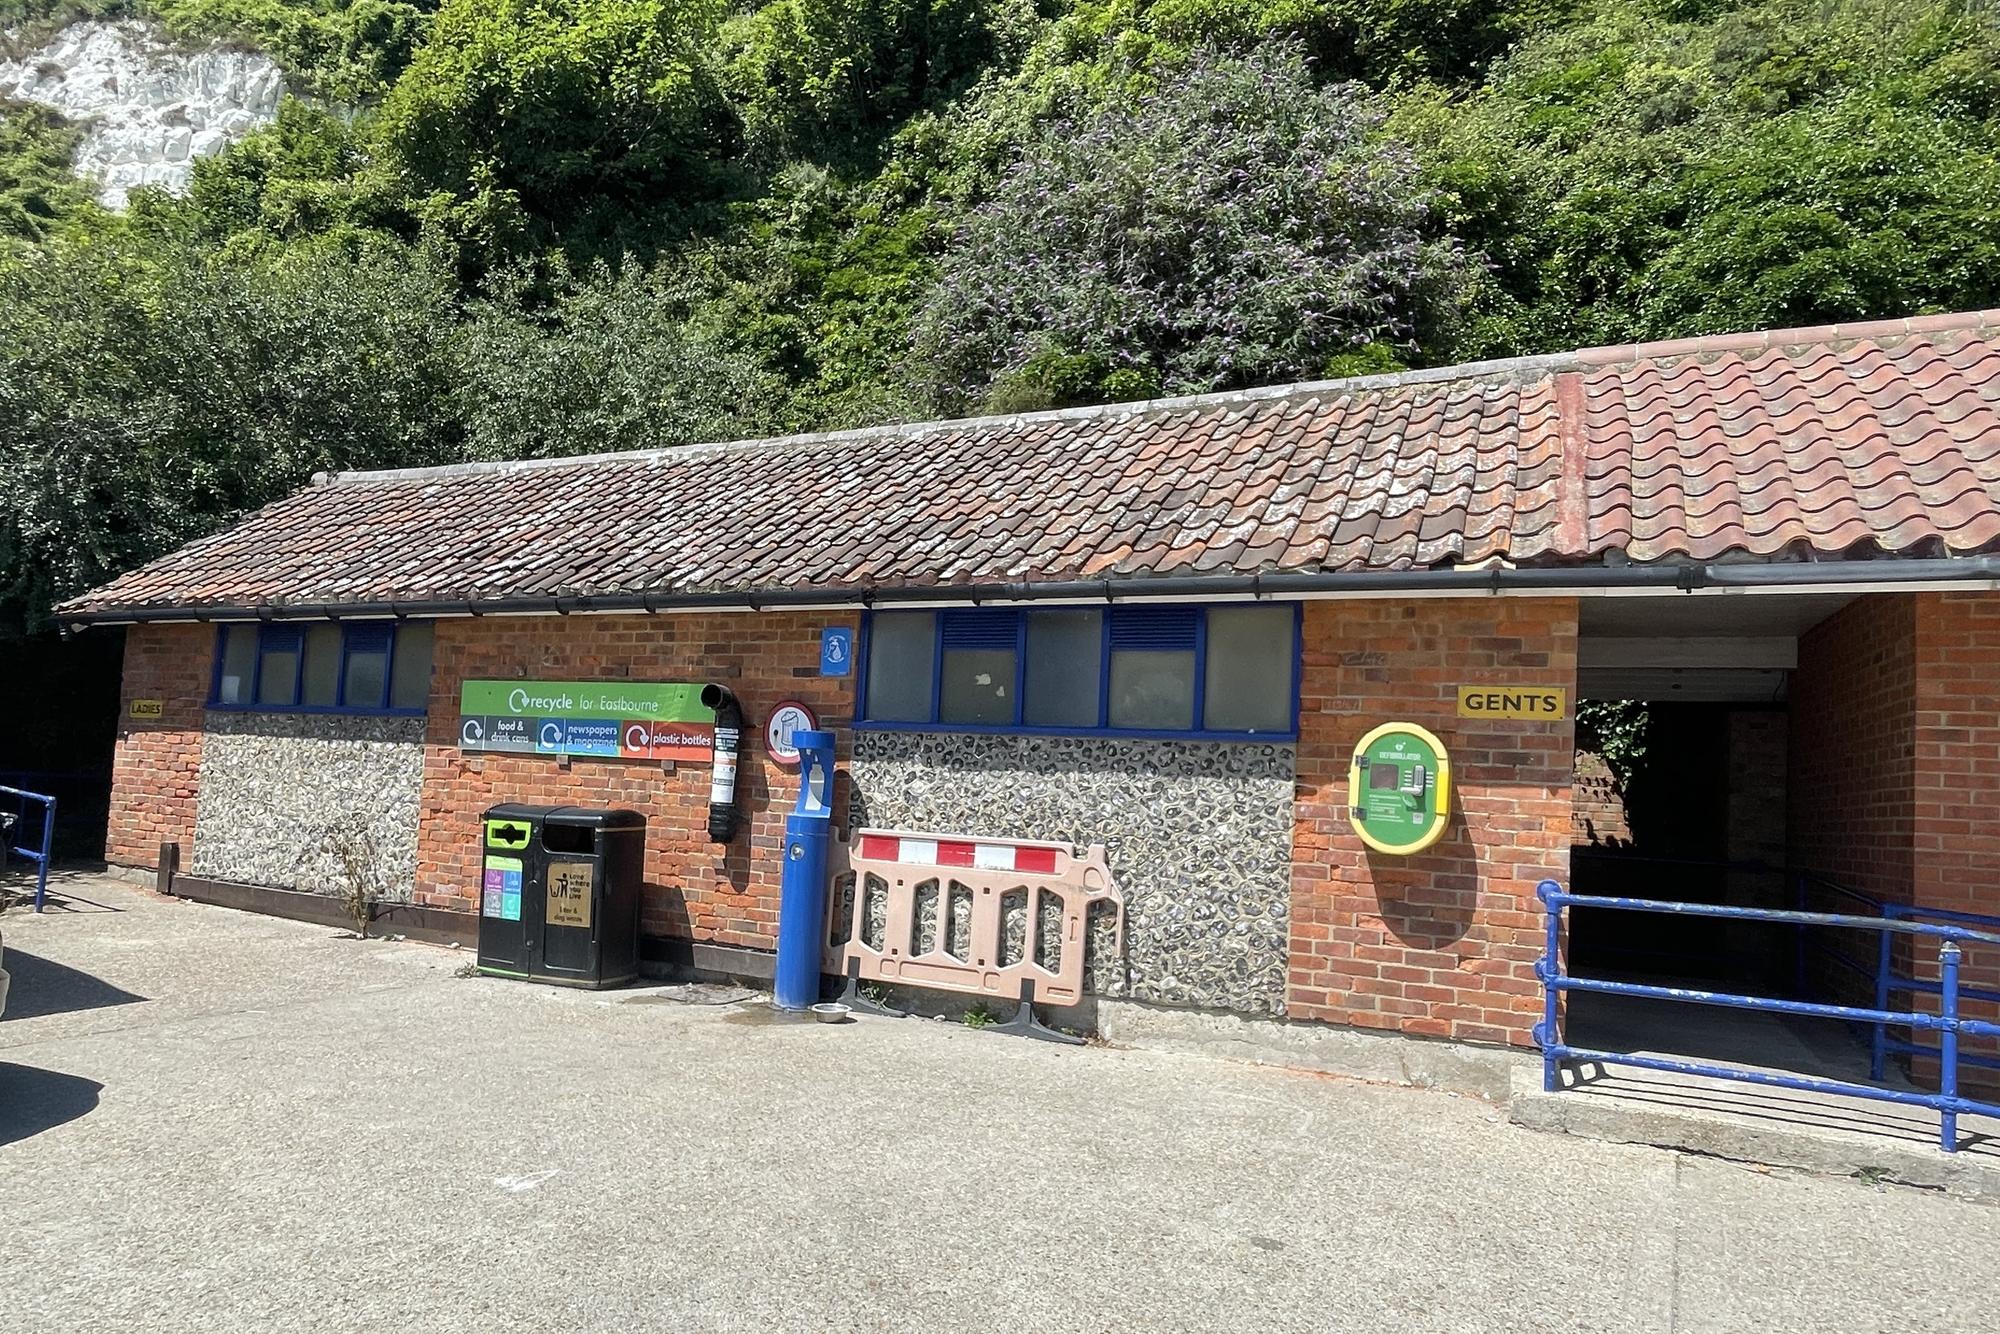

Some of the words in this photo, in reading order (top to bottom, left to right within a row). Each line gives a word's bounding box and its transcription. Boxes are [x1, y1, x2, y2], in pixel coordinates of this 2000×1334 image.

[131, 704, 161, 713] LADIES
[530, 693, 573, 715] recycle
[579, 694, 594, 710] for
[599, 695, 659, 712] Eastbourne
[1465, 693, 1557, 712] GENTS
[497, 720, 516, 732] food
[516, 722, 524, 732] &
[567, 726, 618, 739] newspapers
[491, 731, 510, 743] drink
[511, 735, 529, 744] cans
[566, 736, 574, 746] &
[574, 737, 618, 749] magazines
[653, 732, 681, 746] plastic
[681, 733, 712, 746] bottles
